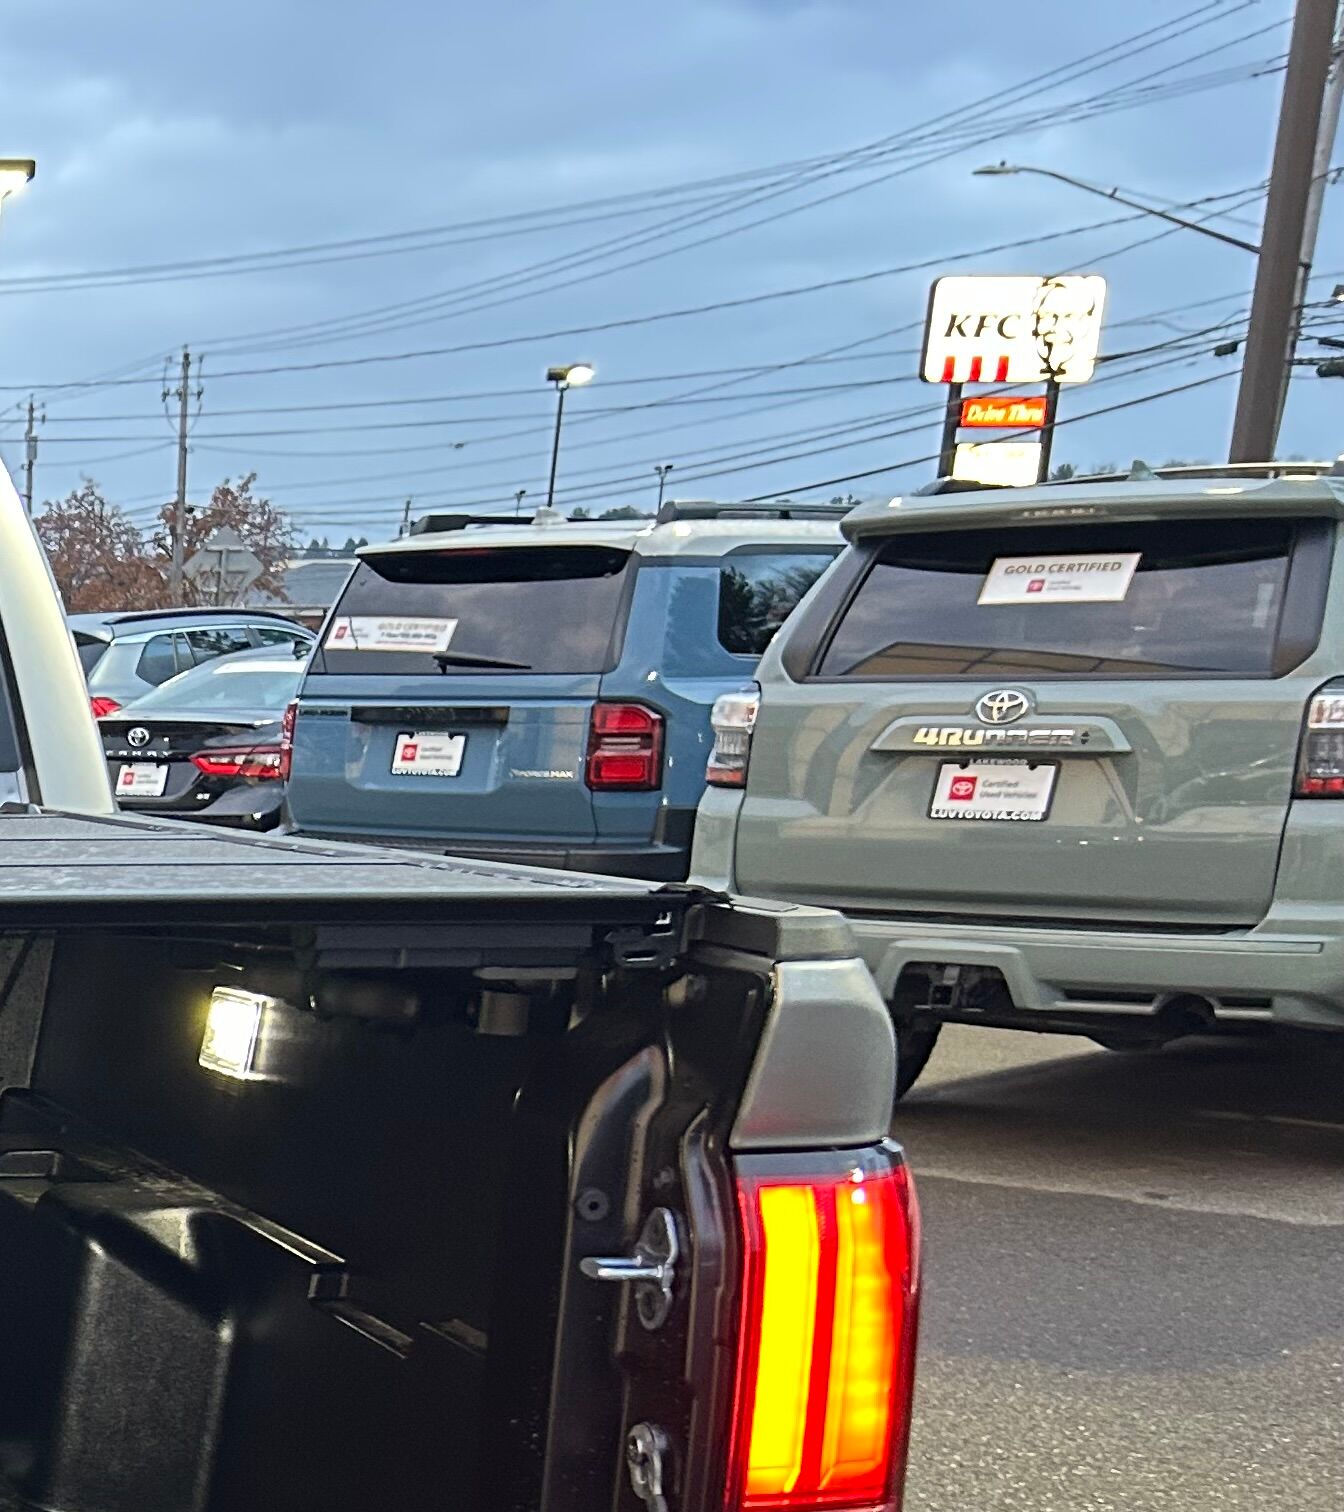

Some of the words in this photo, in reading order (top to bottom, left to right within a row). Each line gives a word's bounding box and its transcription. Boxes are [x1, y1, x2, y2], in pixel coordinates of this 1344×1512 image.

[943, 313, 1021, 340] KFC
[1003, 564, 1046, 575] GOLD
[1048, 561, 1122, 573] CERTIFIED
[969, 758, 1028, 766] LAKEWOOD
